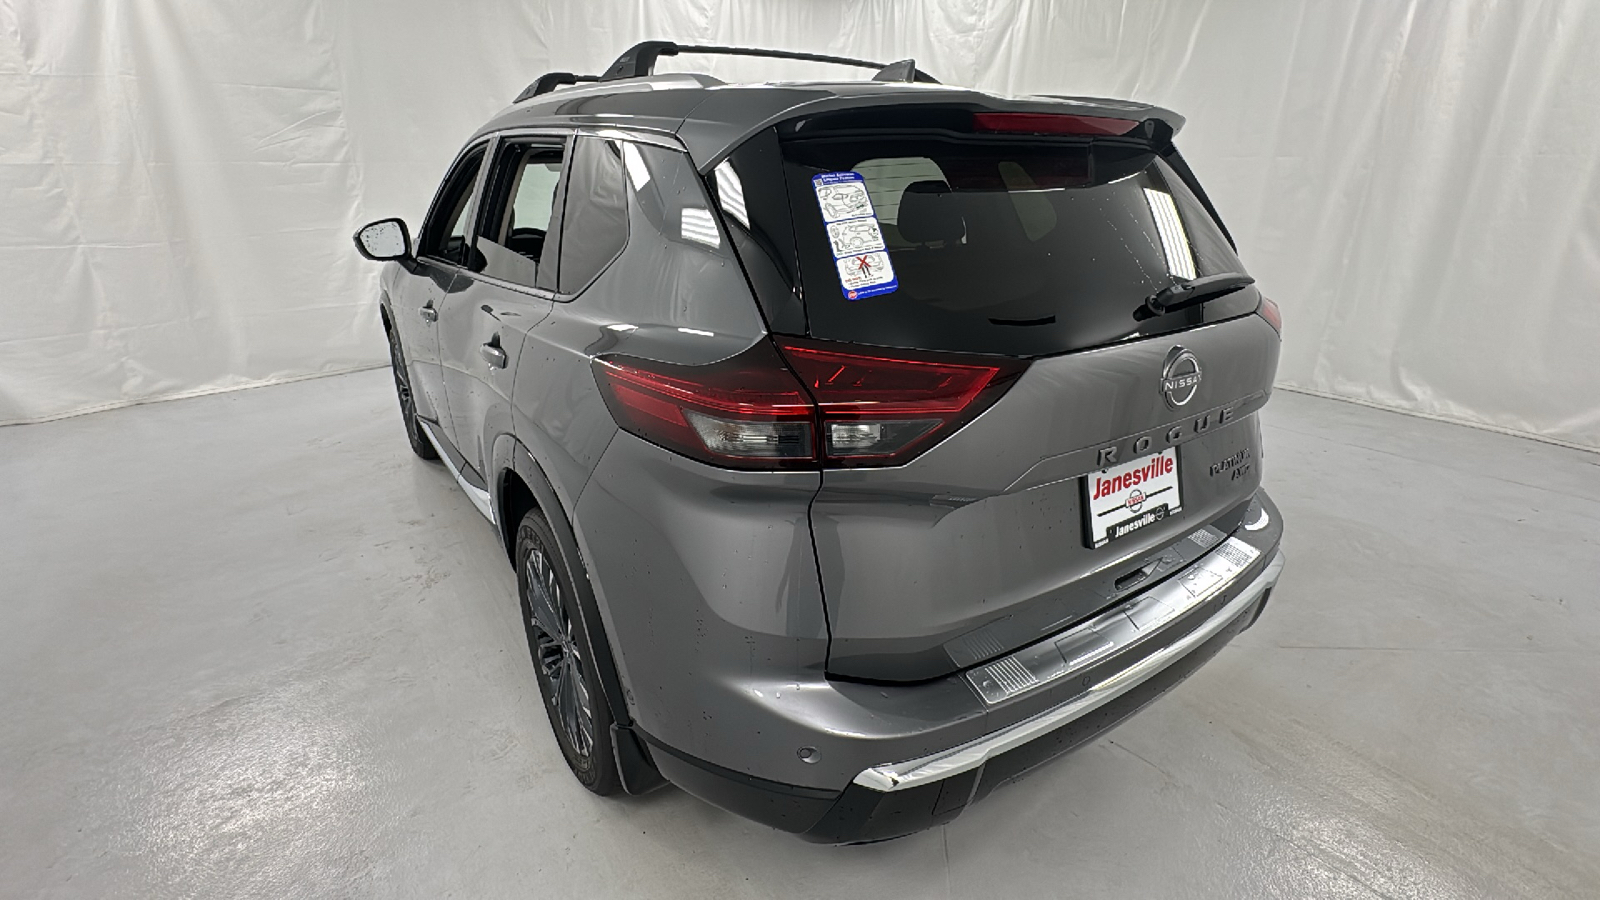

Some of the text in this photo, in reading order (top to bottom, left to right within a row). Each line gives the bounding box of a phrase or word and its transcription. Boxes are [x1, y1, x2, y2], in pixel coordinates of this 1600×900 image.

[1164, 374, 1202, 391] NISSAN
[1097, 406, 1234, 466] ROGUE
[1093, 454, 1174, 500] Janesville
[1114, 512, 1156, 538] Janesville
